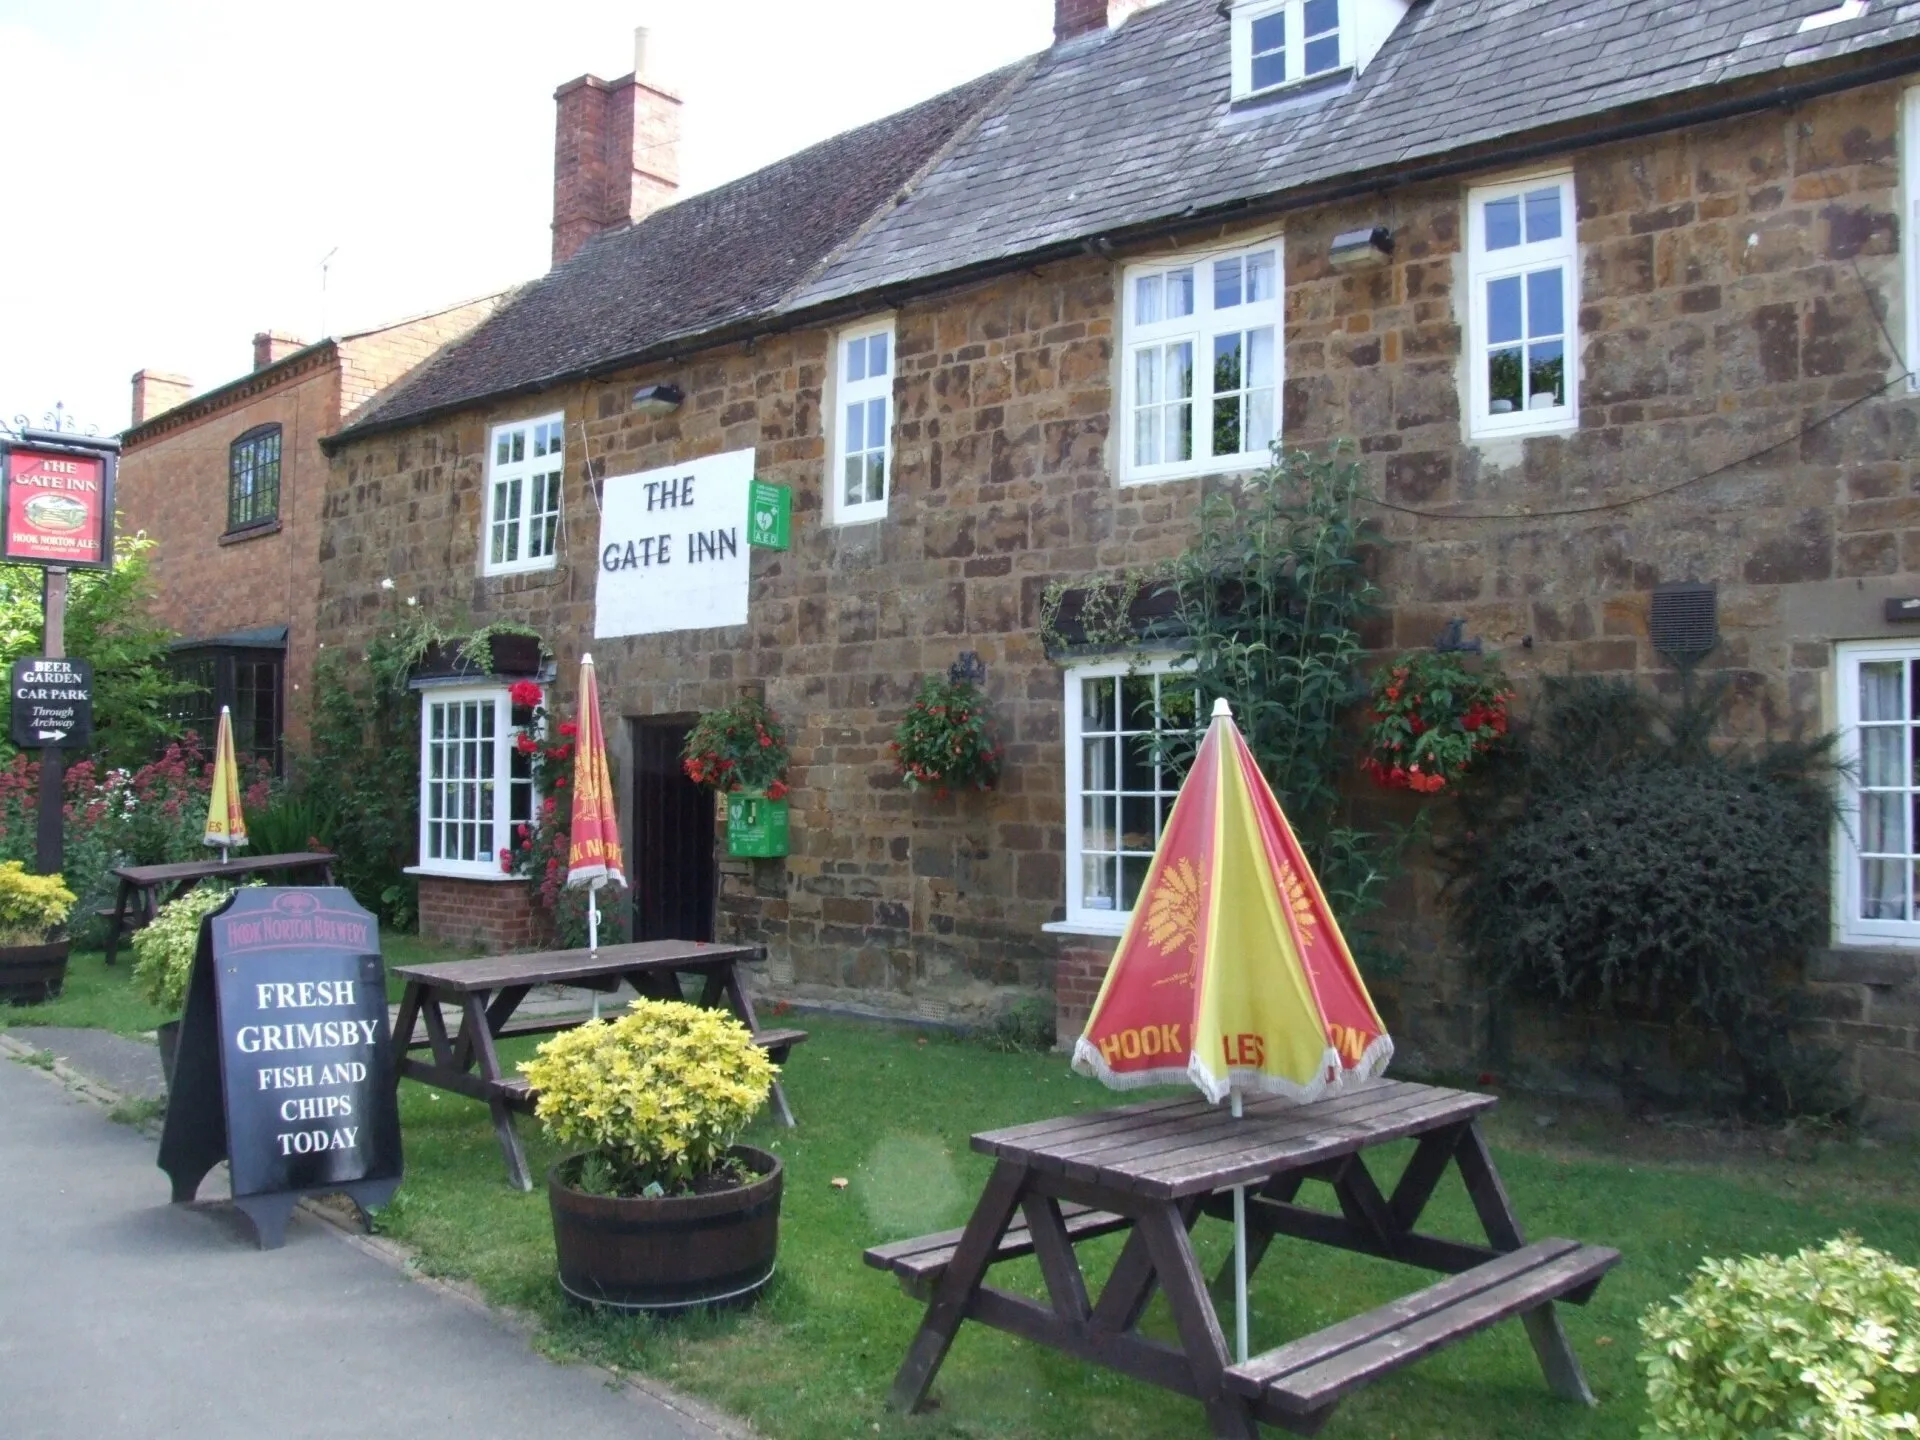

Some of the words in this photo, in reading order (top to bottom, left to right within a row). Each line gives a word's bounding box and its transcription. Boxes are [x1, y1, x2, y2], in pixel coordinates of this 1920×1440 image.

[42, 460, 77, 474] THE
[15, 473, 64, 489] GATE
[66, 478, 97, 492] INN
[643, 475, 695, 511] THE
[12, 532, 38, 544] HOOK
[40, 535, 76, 547] NORTON
[76, 539, 100, 549] ALES
[602, 533, 671, 572] GATE
[688, 527, 737, 564] INN
[755, 532, 777, 545] AED
[22, 671, 82, 684] GARDEN
[34, 661, 72, 673] BEER
[17, 688, 47, 699] CAR
[51, 689, 88, 700] PARK
[32, 706, 74, 718] Through
[31, 718, 75, 729] Archway
[208, 821, 222, 833] ES
[228, 919, 260, 949] HOOK
[263, 916, 313, 942] NORTON
[315, 916, 368, 948] BREWERY
[256, 980, 356, 1010] FRESH
[236, 1019, 379, 1053] GRIMSBY
[1099, 1023, 1183, 1066] HOOK
[1222, 1033, 1265, 1068] LES
[258, 1065, 314, 1090] FISH
[319, 1062, 367, 1085] AND
[280, 1095, 351, 1121] CHIPS
[277, 1126, 359, 1155] TODAY
